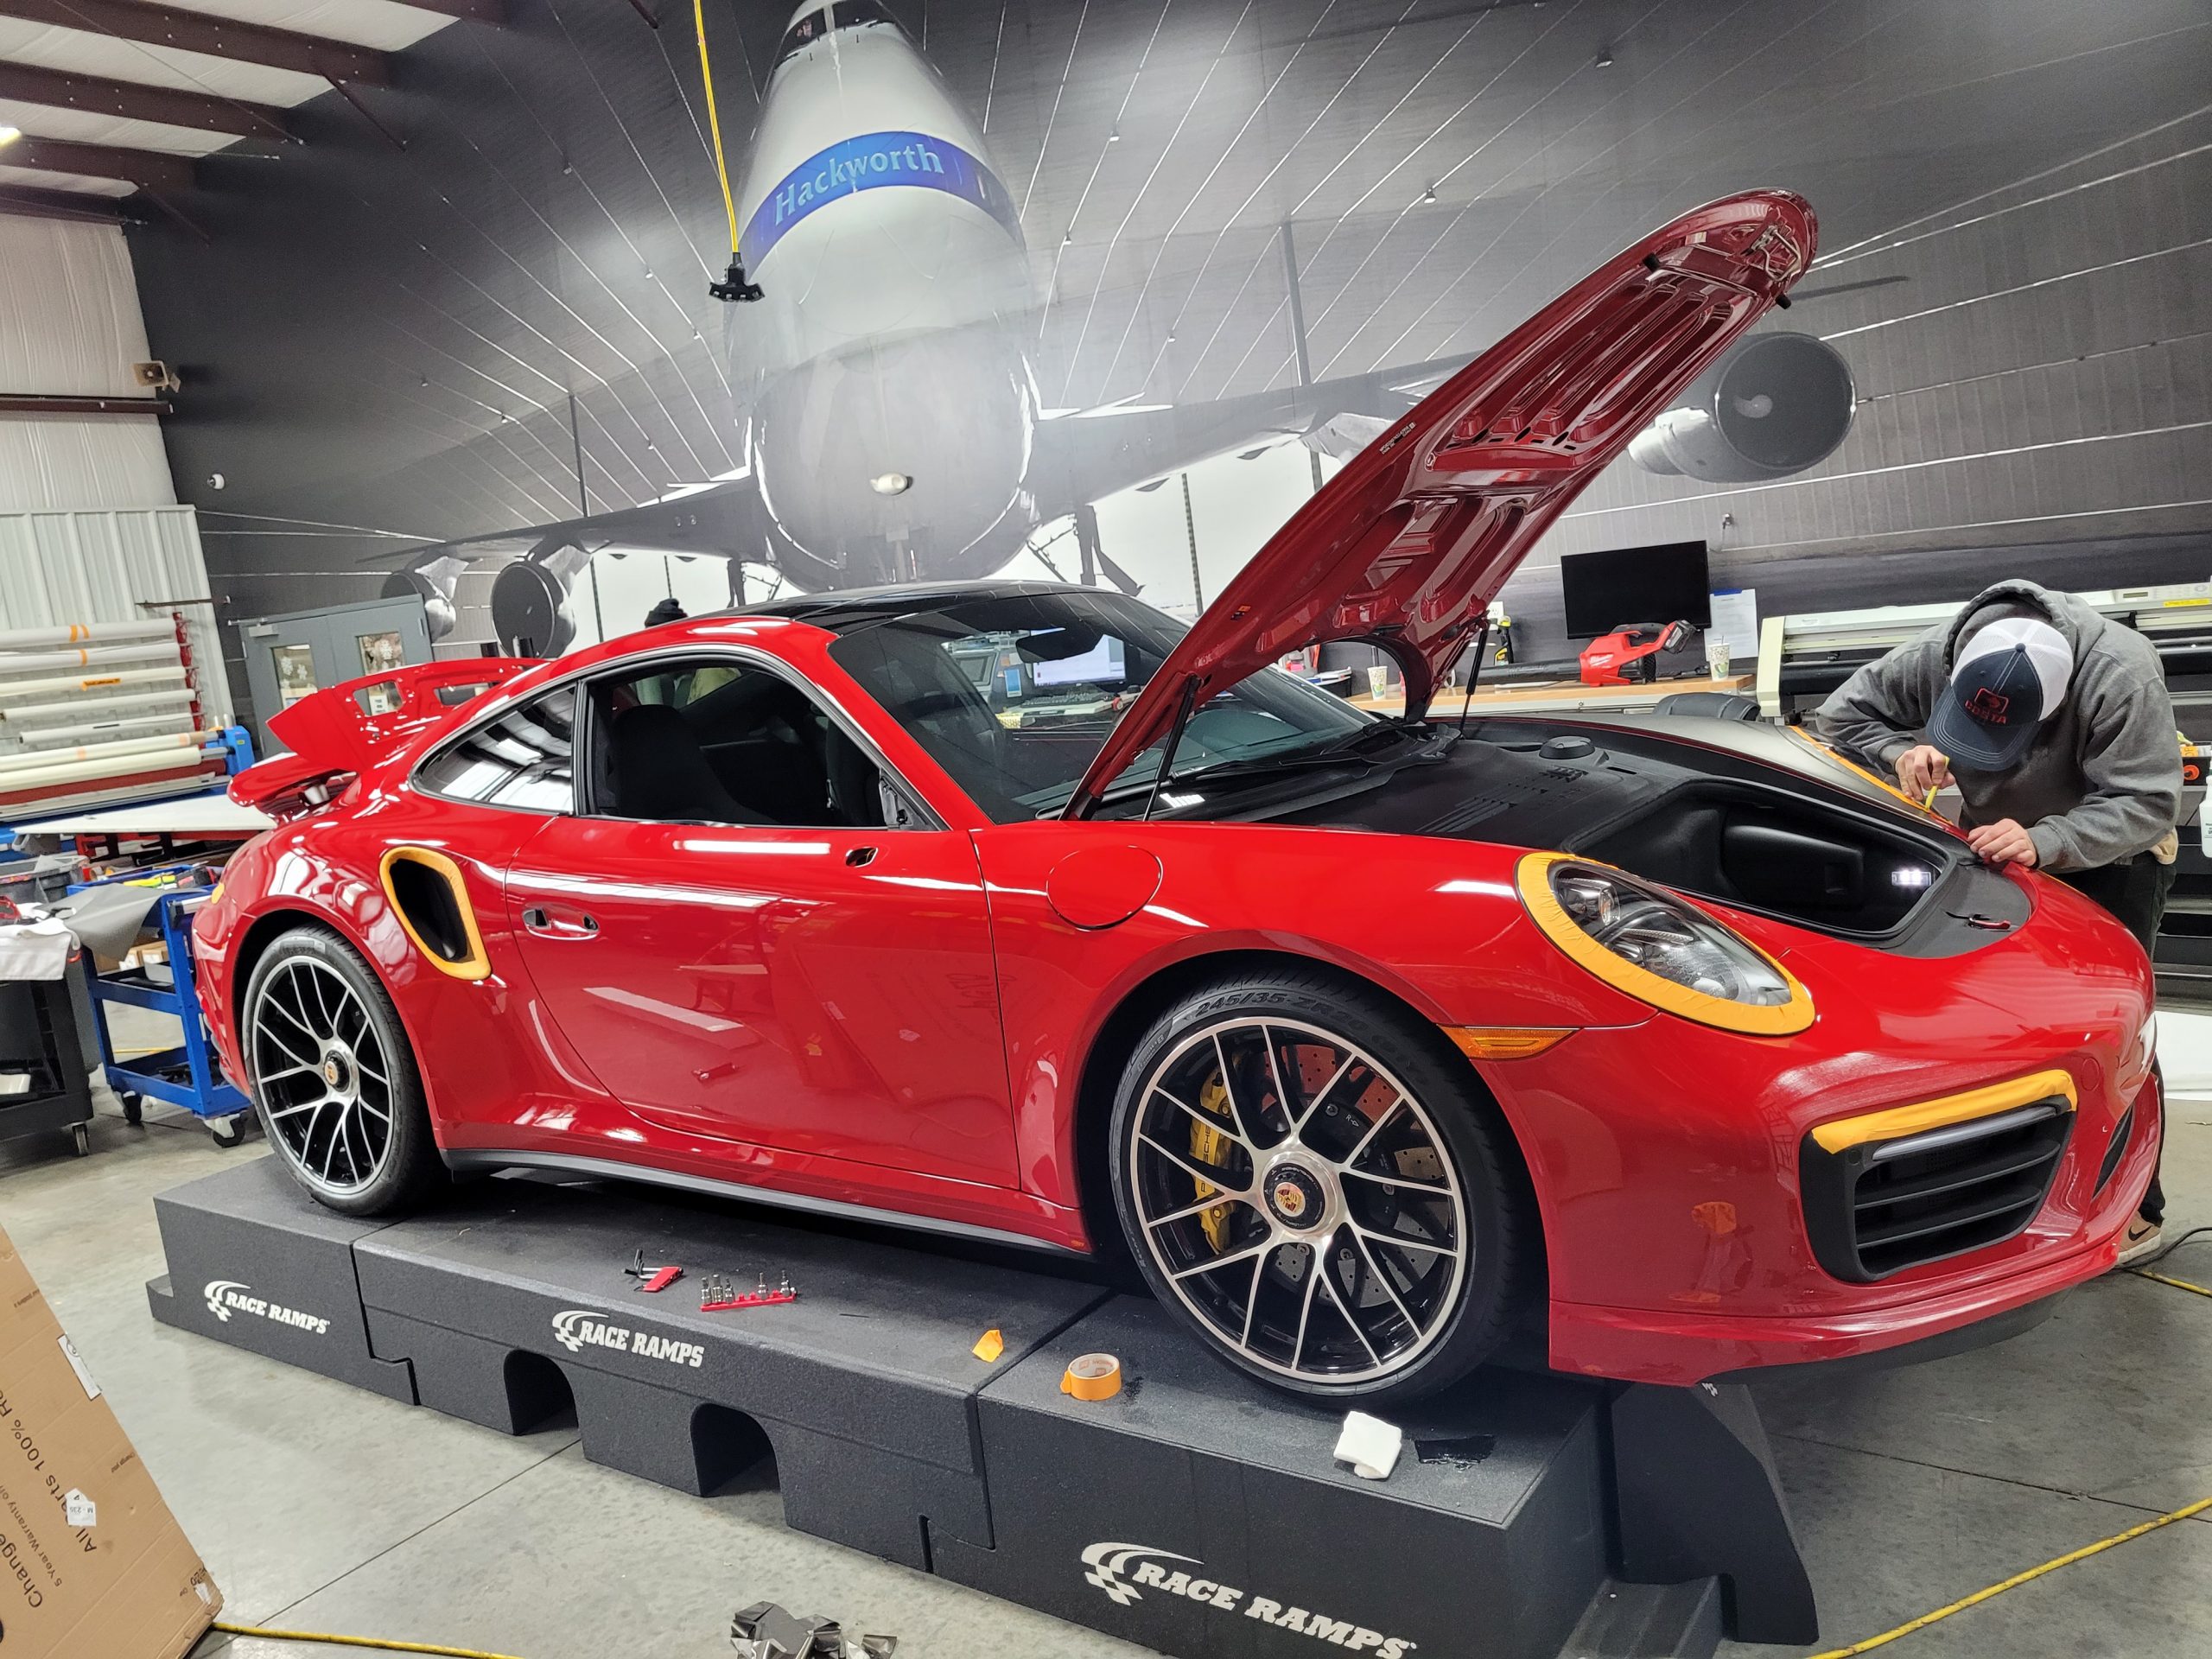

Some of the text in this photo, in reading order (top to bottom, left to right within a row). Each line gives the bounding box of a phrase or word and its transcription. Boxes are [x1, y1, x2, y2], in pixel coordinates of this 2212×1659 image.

[775, 143, 944, 226] Hackworth
[1201, 1125, 1211, 1192] PSCHE
[226, 1291, 330, 1334] RACE RAMPS
[579, 1320, 705, 1368] RACE RAMPS
[10, 1420, 45, 1471] 100%
[8, 1501, 39, 1553] Warranty
[76, 1528, 97, 1553] All
[0, 1534, 42, 1608] Change
[41, 1551, 58, 1579] Year
[54, 1578, 62, 1586] 5
[1132, 1561, 1411, 1659] RACE RAMPS
